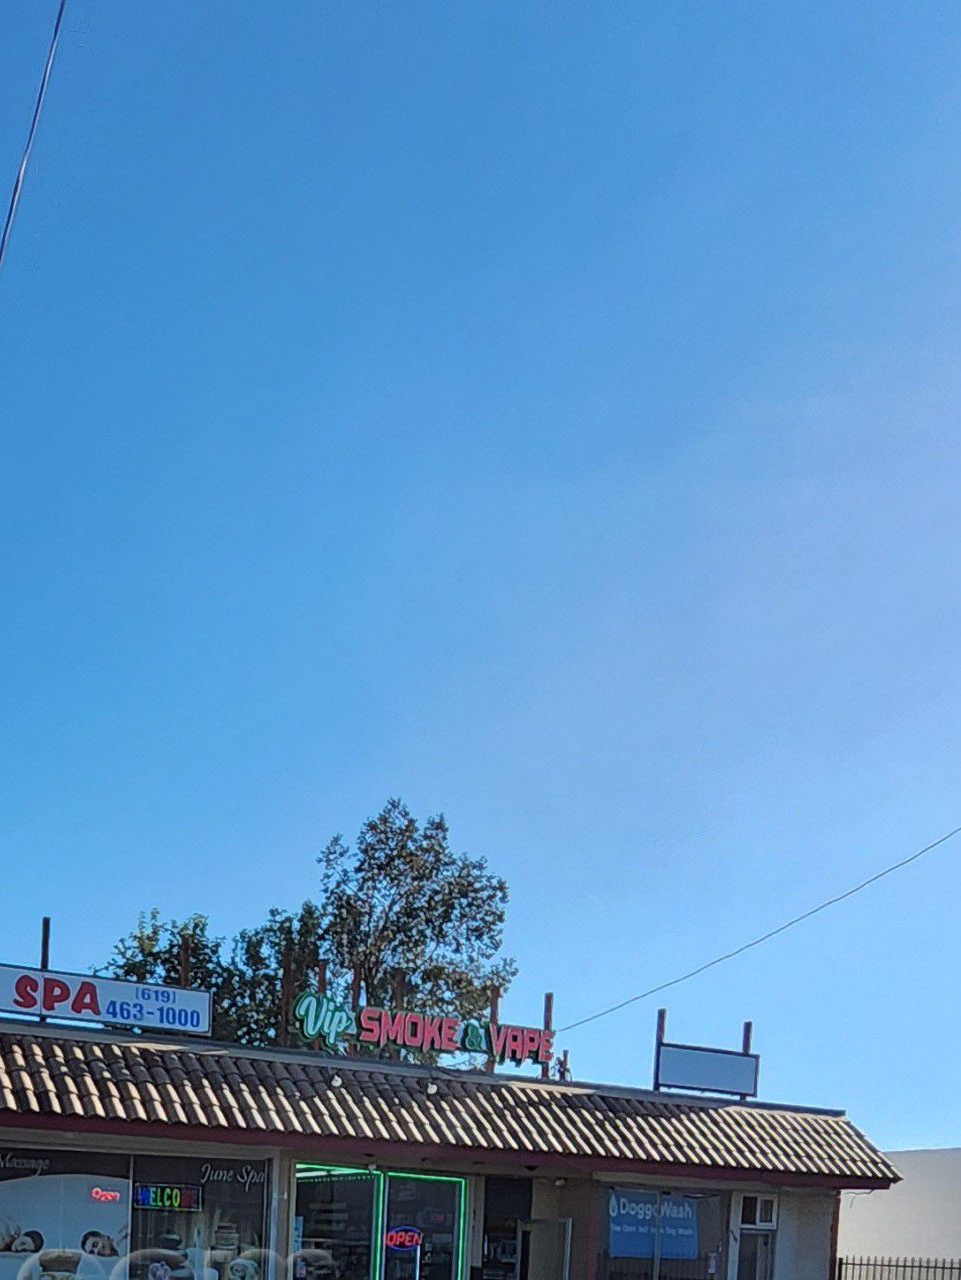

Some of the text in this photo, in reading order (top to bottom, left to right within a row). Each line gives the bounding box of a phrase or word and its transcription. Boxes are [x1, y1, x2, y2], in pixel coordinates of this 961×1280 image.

[13, 974, 102, 1016] SPA
[105, 1000, 201, 1029] 463-1000
[359, 1006, 462, 1051] SMOKE
[463, 1020, 486, 1051] &
[489, 1023, 557, 1063] VAPE
[200, 1163, 267, 1192] June Spa
[660, 1201, 692, 1218] Wash
[384, 1231, 424, 1247] OPEN
